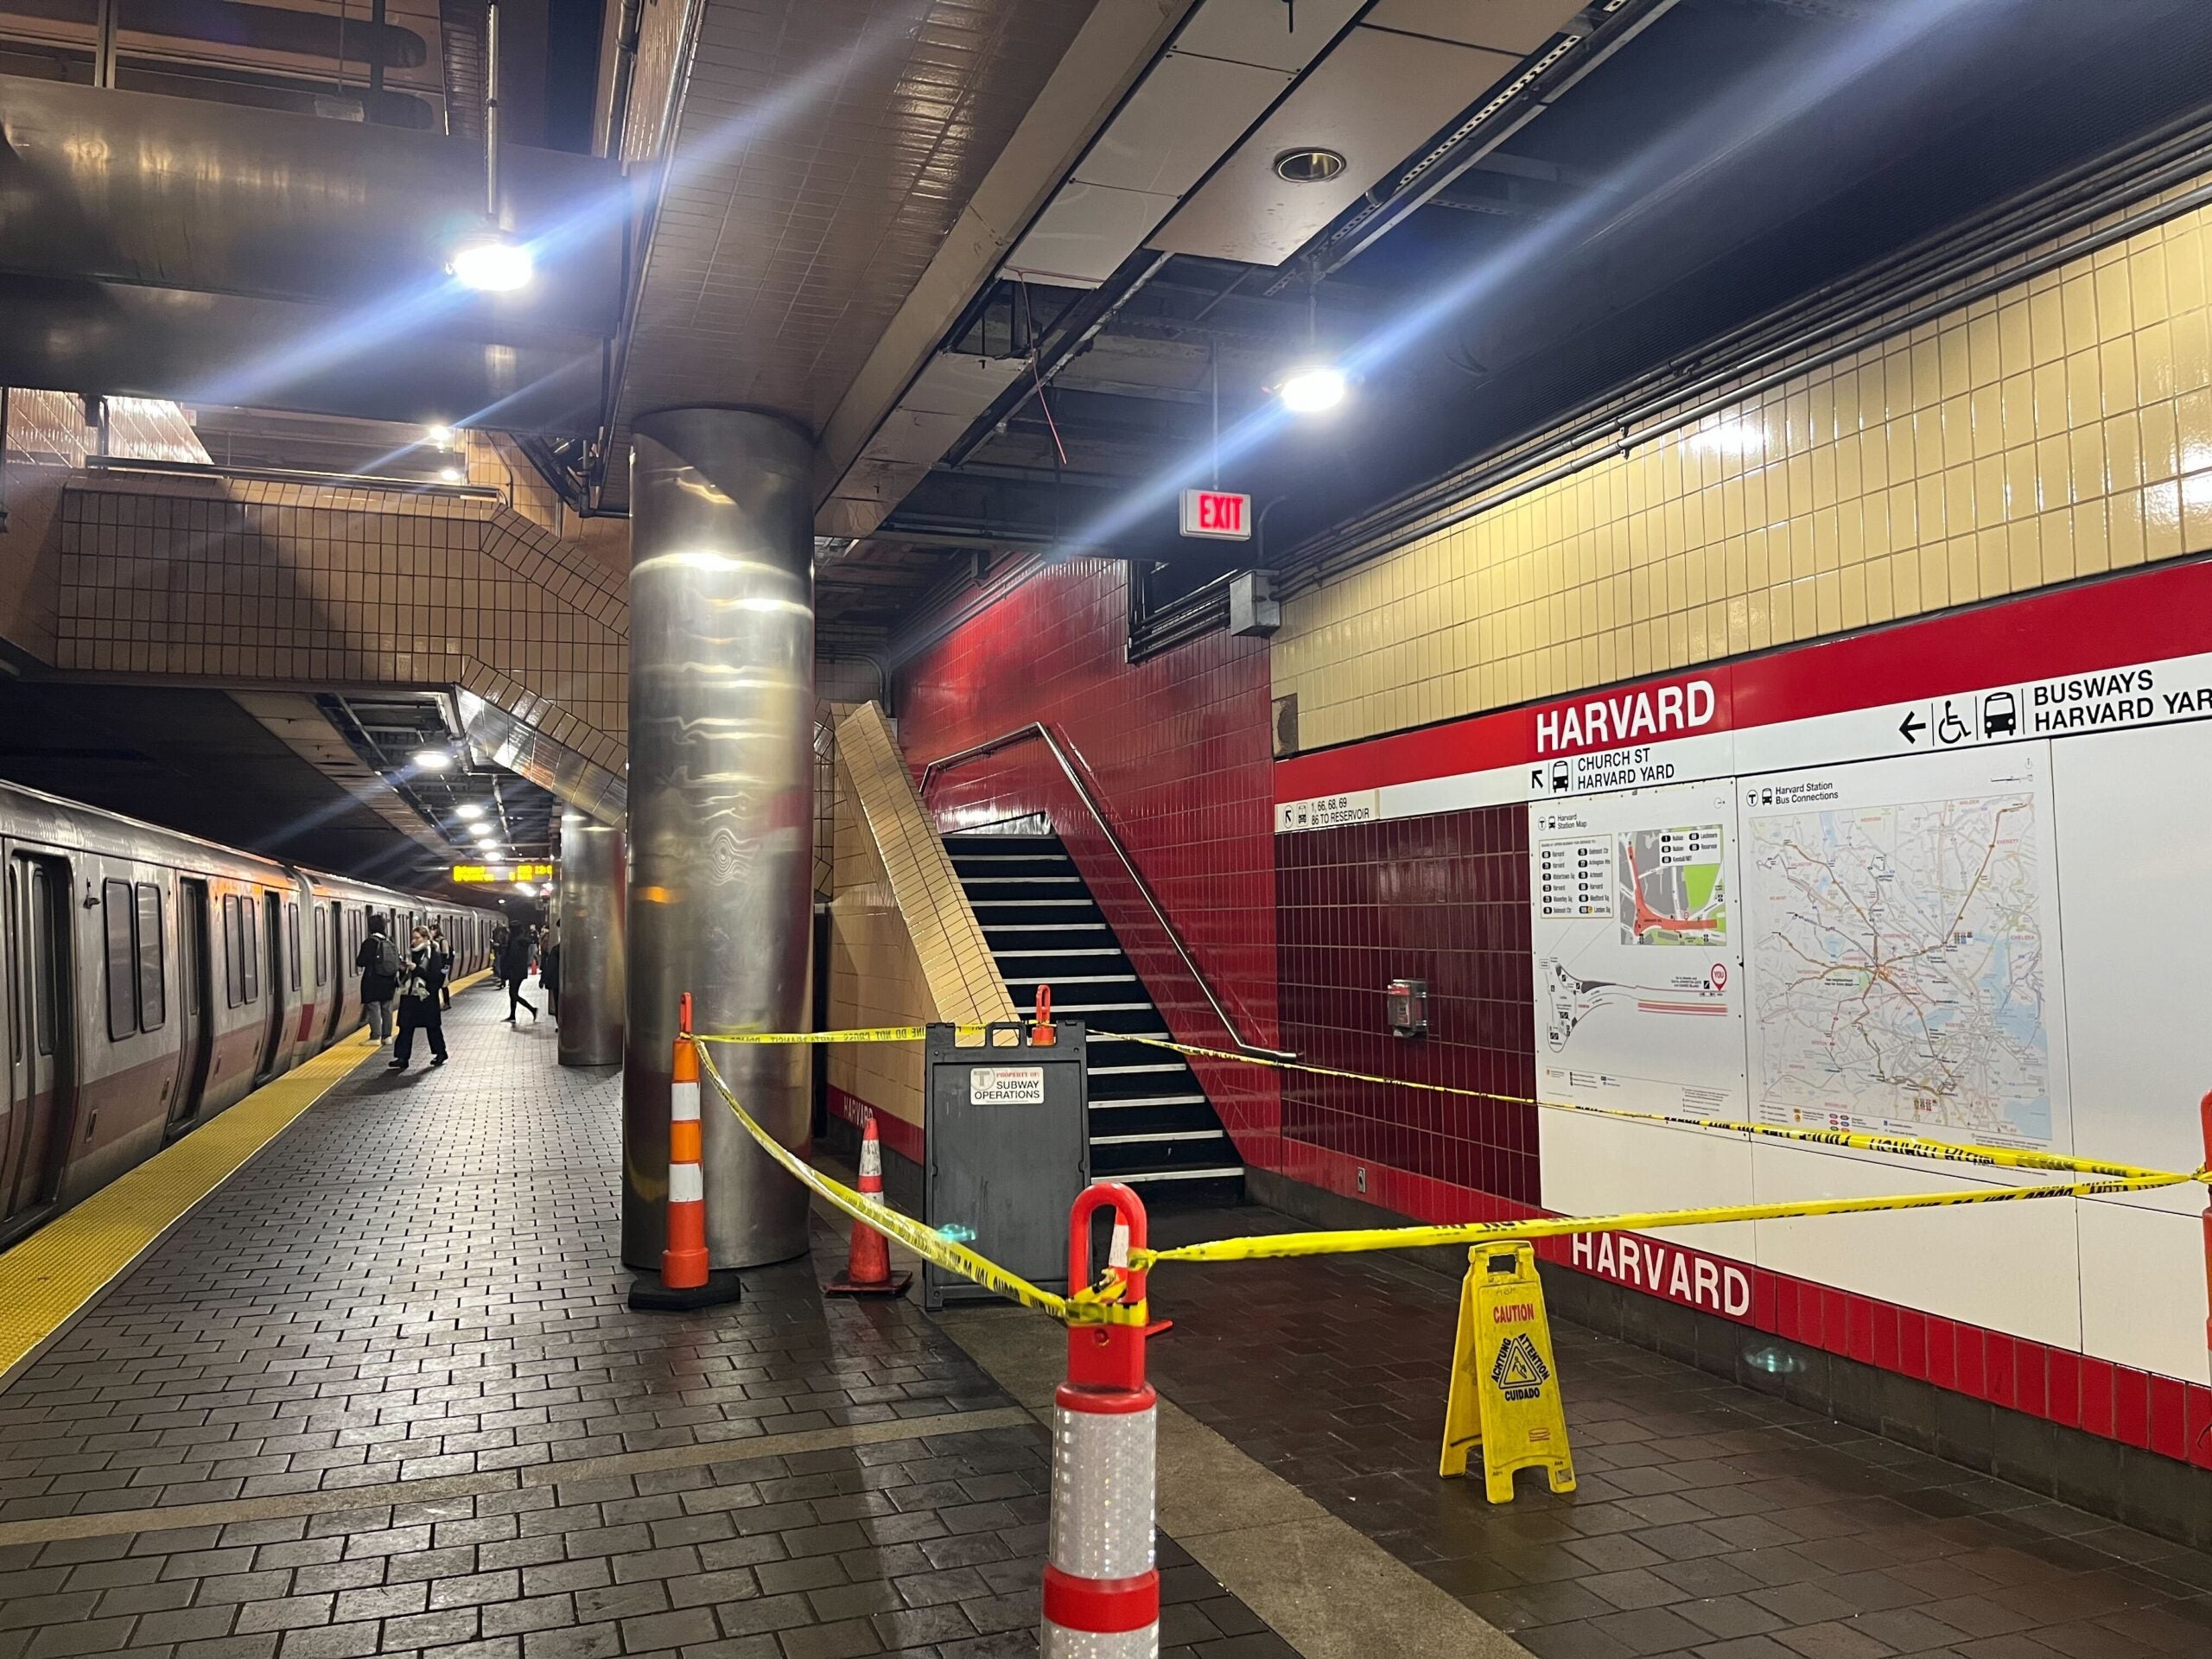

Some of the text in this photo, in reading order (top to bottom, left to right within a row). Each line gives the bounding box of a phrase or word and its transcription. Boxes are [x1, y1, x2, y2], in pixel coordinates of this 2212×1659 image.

[1199, 494, 1243, 532] EXIT
[2034, 669, 2153, 706] BUSWAYS
[1536, 680, 1715, 753] HARVARD
[2035, 697, 2154, 732] HARVARD
[1578, 747, 1650, 772] CHURCH ST
[1578, 764, 1675, 790] HARVARD YARD
[1776, 782, 1833, 795] Harvard Station
[1318, 801, 1326, 812] 66,
[1338, 798, 1347, 809] 69
[1776, 791, 1839, 804] Bus Connections
[1312, 808, 1370, 825] 86 TO RESERVOIR
[1714, 970, 1724, 979] YOU
[975, 1090, 1040, 1100] OPERATIONS
[996, 1080, 1039, 1090] SUBWAY
[1573, 1232, 1750, 1317] HARVARD
[1493, 1303, 1535, 1324] CAUTION
[1491, 1338, 1511, 1382] ACHTUNG
[1518, 1333, 1550, 1380] ATTENTION
[1504, 1388, 1540, 1402] CUIDADO
